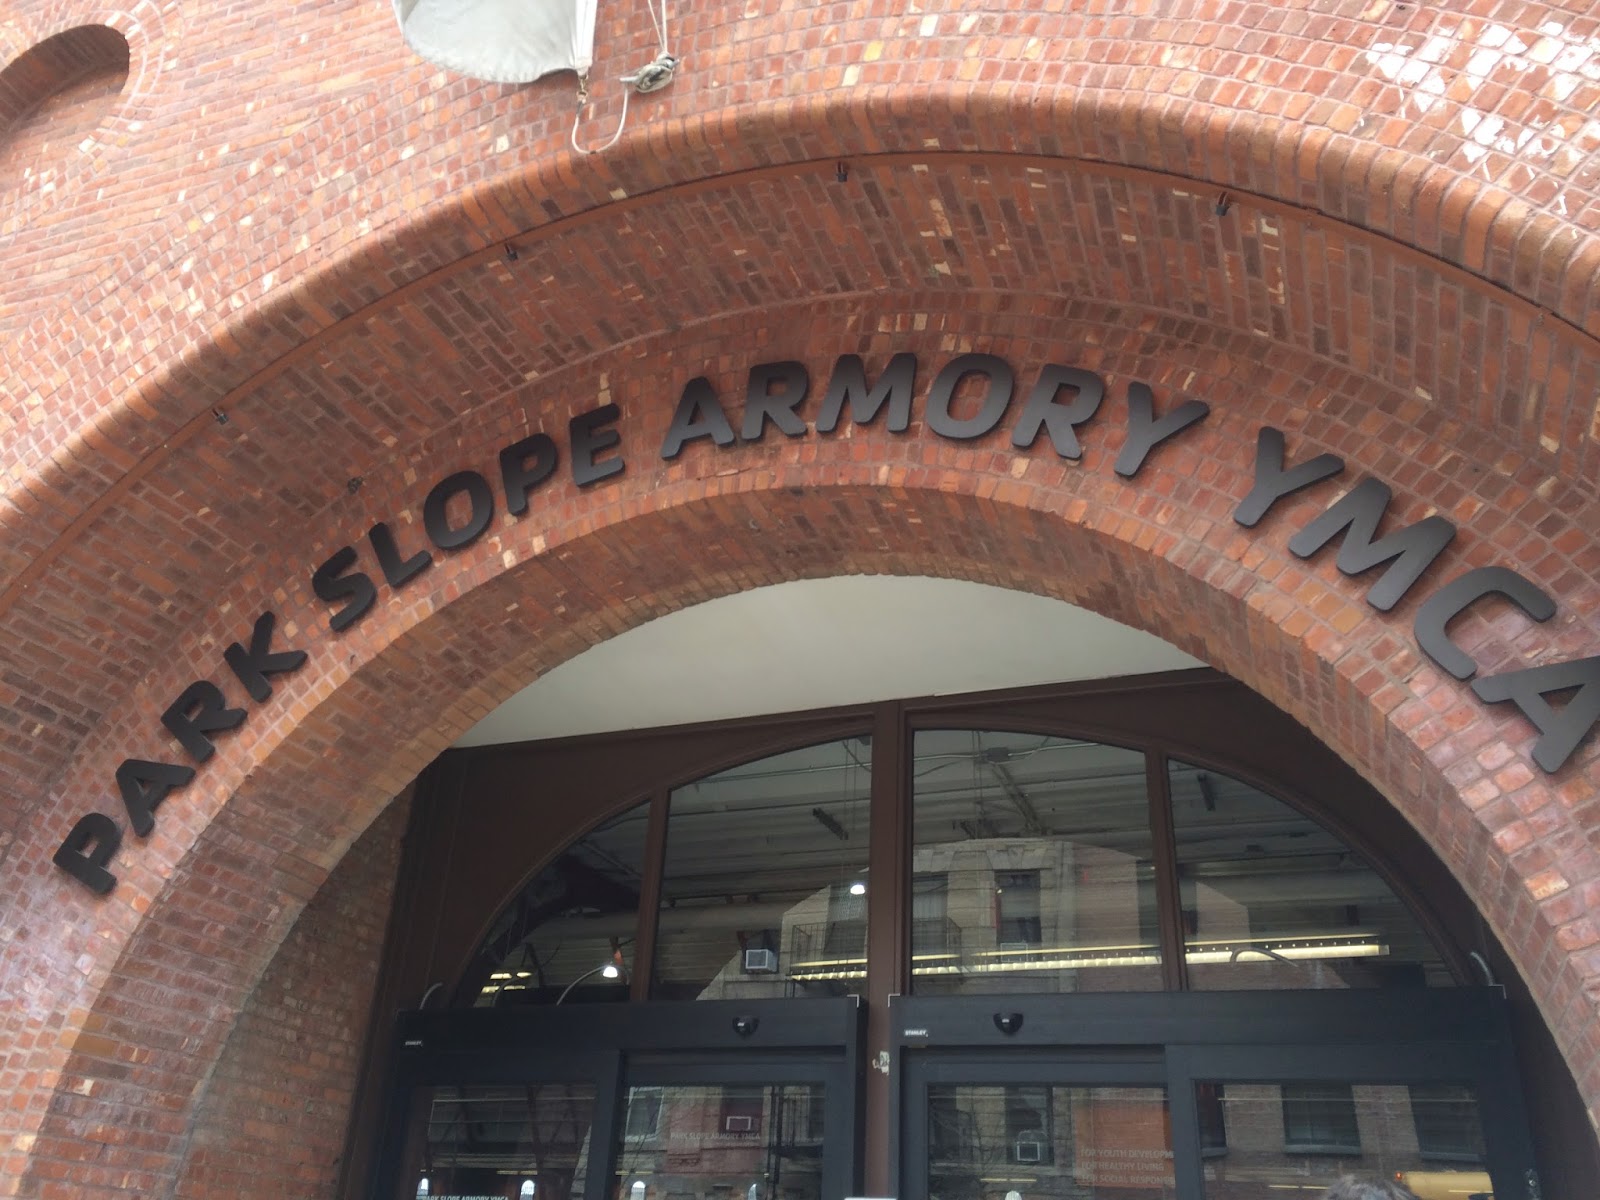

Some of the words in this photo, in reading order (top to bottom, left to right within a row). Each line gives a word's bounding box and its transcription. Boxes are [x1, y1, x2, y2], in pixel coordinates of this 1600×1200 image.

[52, 611, 308, 893] PARK
[311, 403, 625, 632] SLOPE
[661, 352, 1210, 478] ARMORY
[1233, 426, 1600, 774] YMCA
[670, 1131, 688, 1140] PARK
[689, 1131, 710, 1140] SLOPE
[711, 1131, 739, 1140] ARMORY
